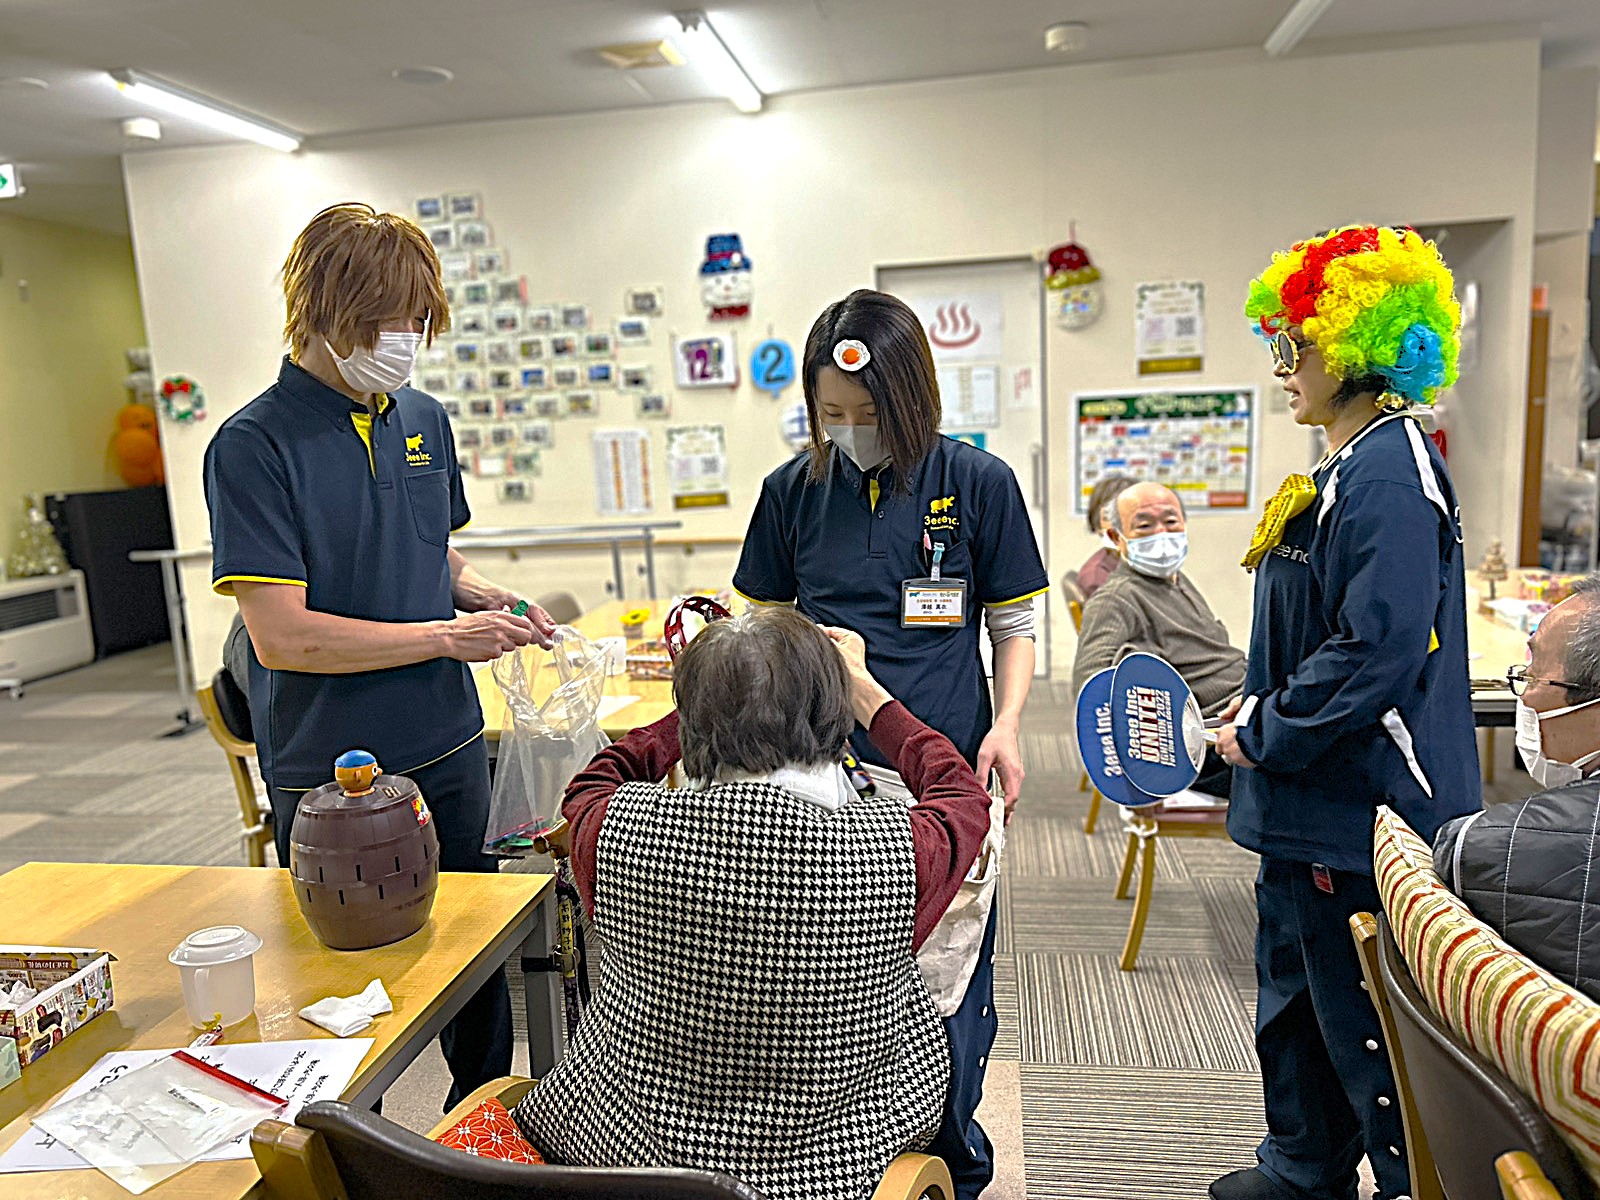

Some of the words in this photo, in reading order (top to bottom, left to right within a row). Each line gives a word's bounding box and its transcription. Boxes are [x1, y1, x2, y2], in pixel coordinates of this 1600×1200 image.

[761, 344, 788, 384] 2
[1096, 703, 1112, 734] Inc.
[1126, 686, 1138, 716] Inc.
[1164, 691, 1173, 720] decade
[1127, 719, 1141, 759] 3eee
[1137, 687, 1160, 763] UNITE!
